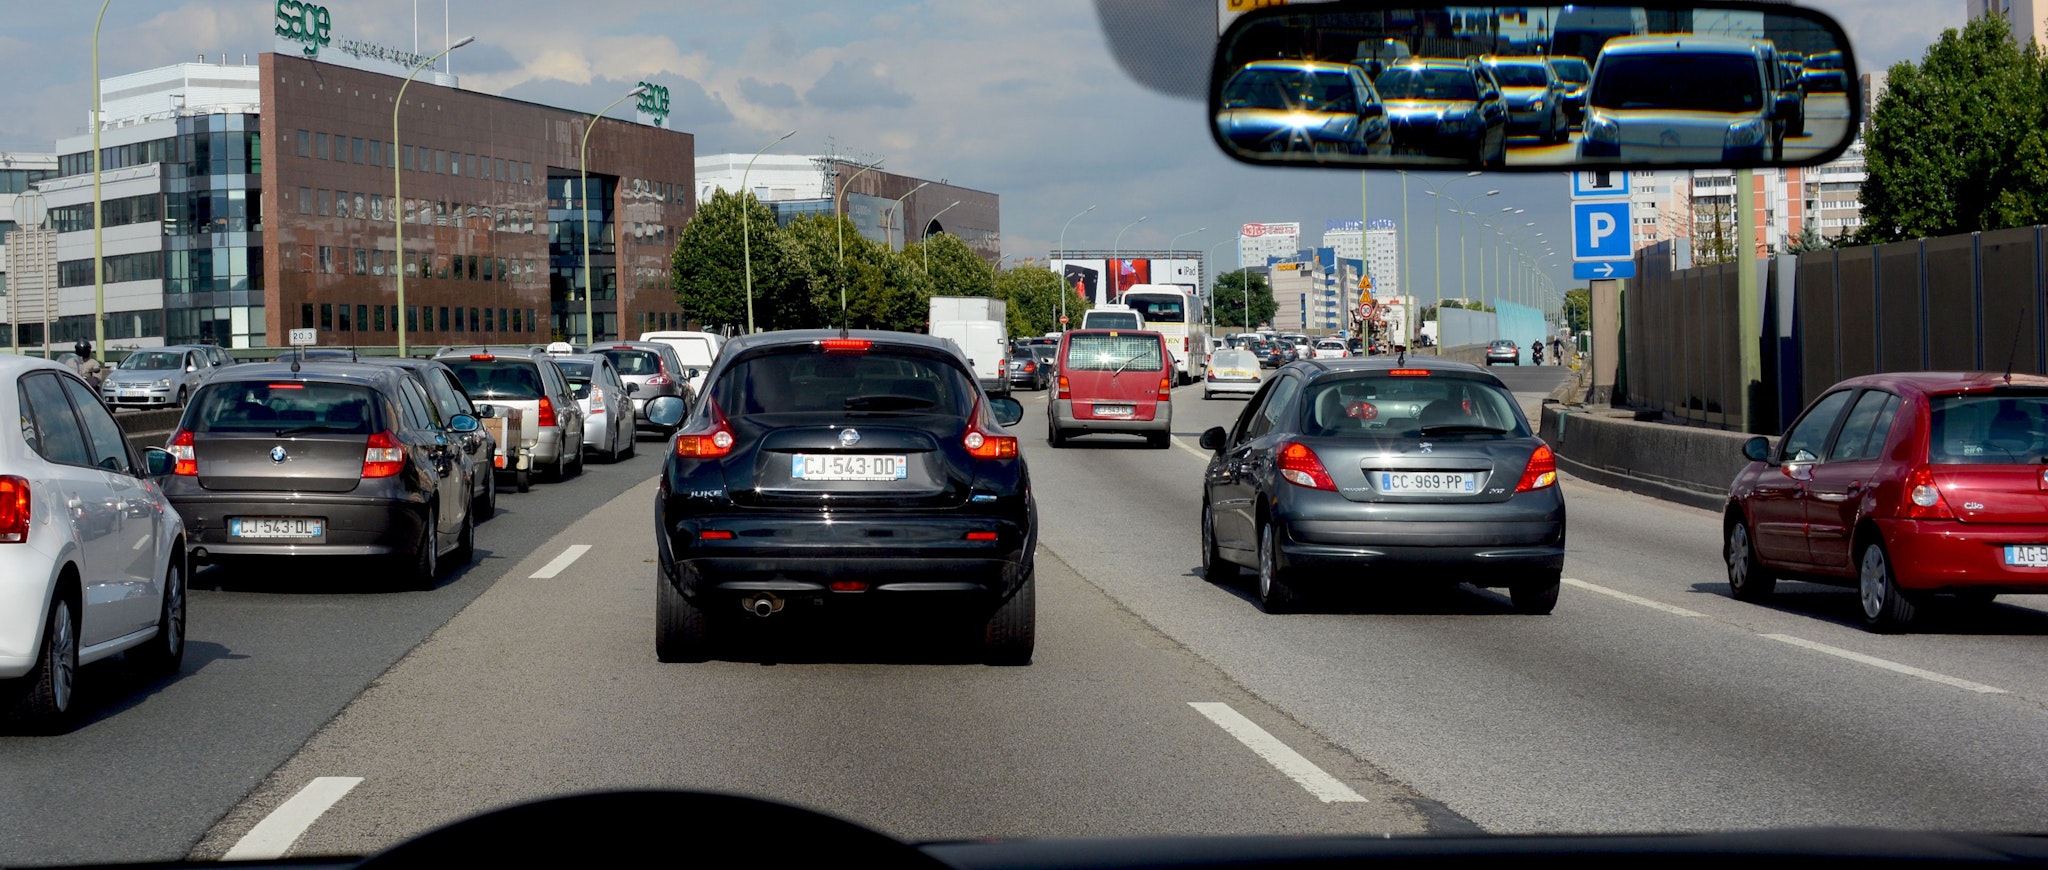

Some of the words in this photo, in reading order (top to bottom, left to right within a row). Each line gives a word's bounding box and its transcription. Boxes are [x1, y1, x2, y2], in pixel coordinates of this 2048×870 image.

[275, 0, 330, 56] sage
[1589, 211, 1617, 249] P
[1183, 266, 1196, 276] iPad
[804, 457, 895, 475] CJ-543-DD
[1392, 474, 1462, 489] CC-969-PP
[687, 490, 722, 499] JUKE
[240, 520, 313, 534] CJ-543-DL
